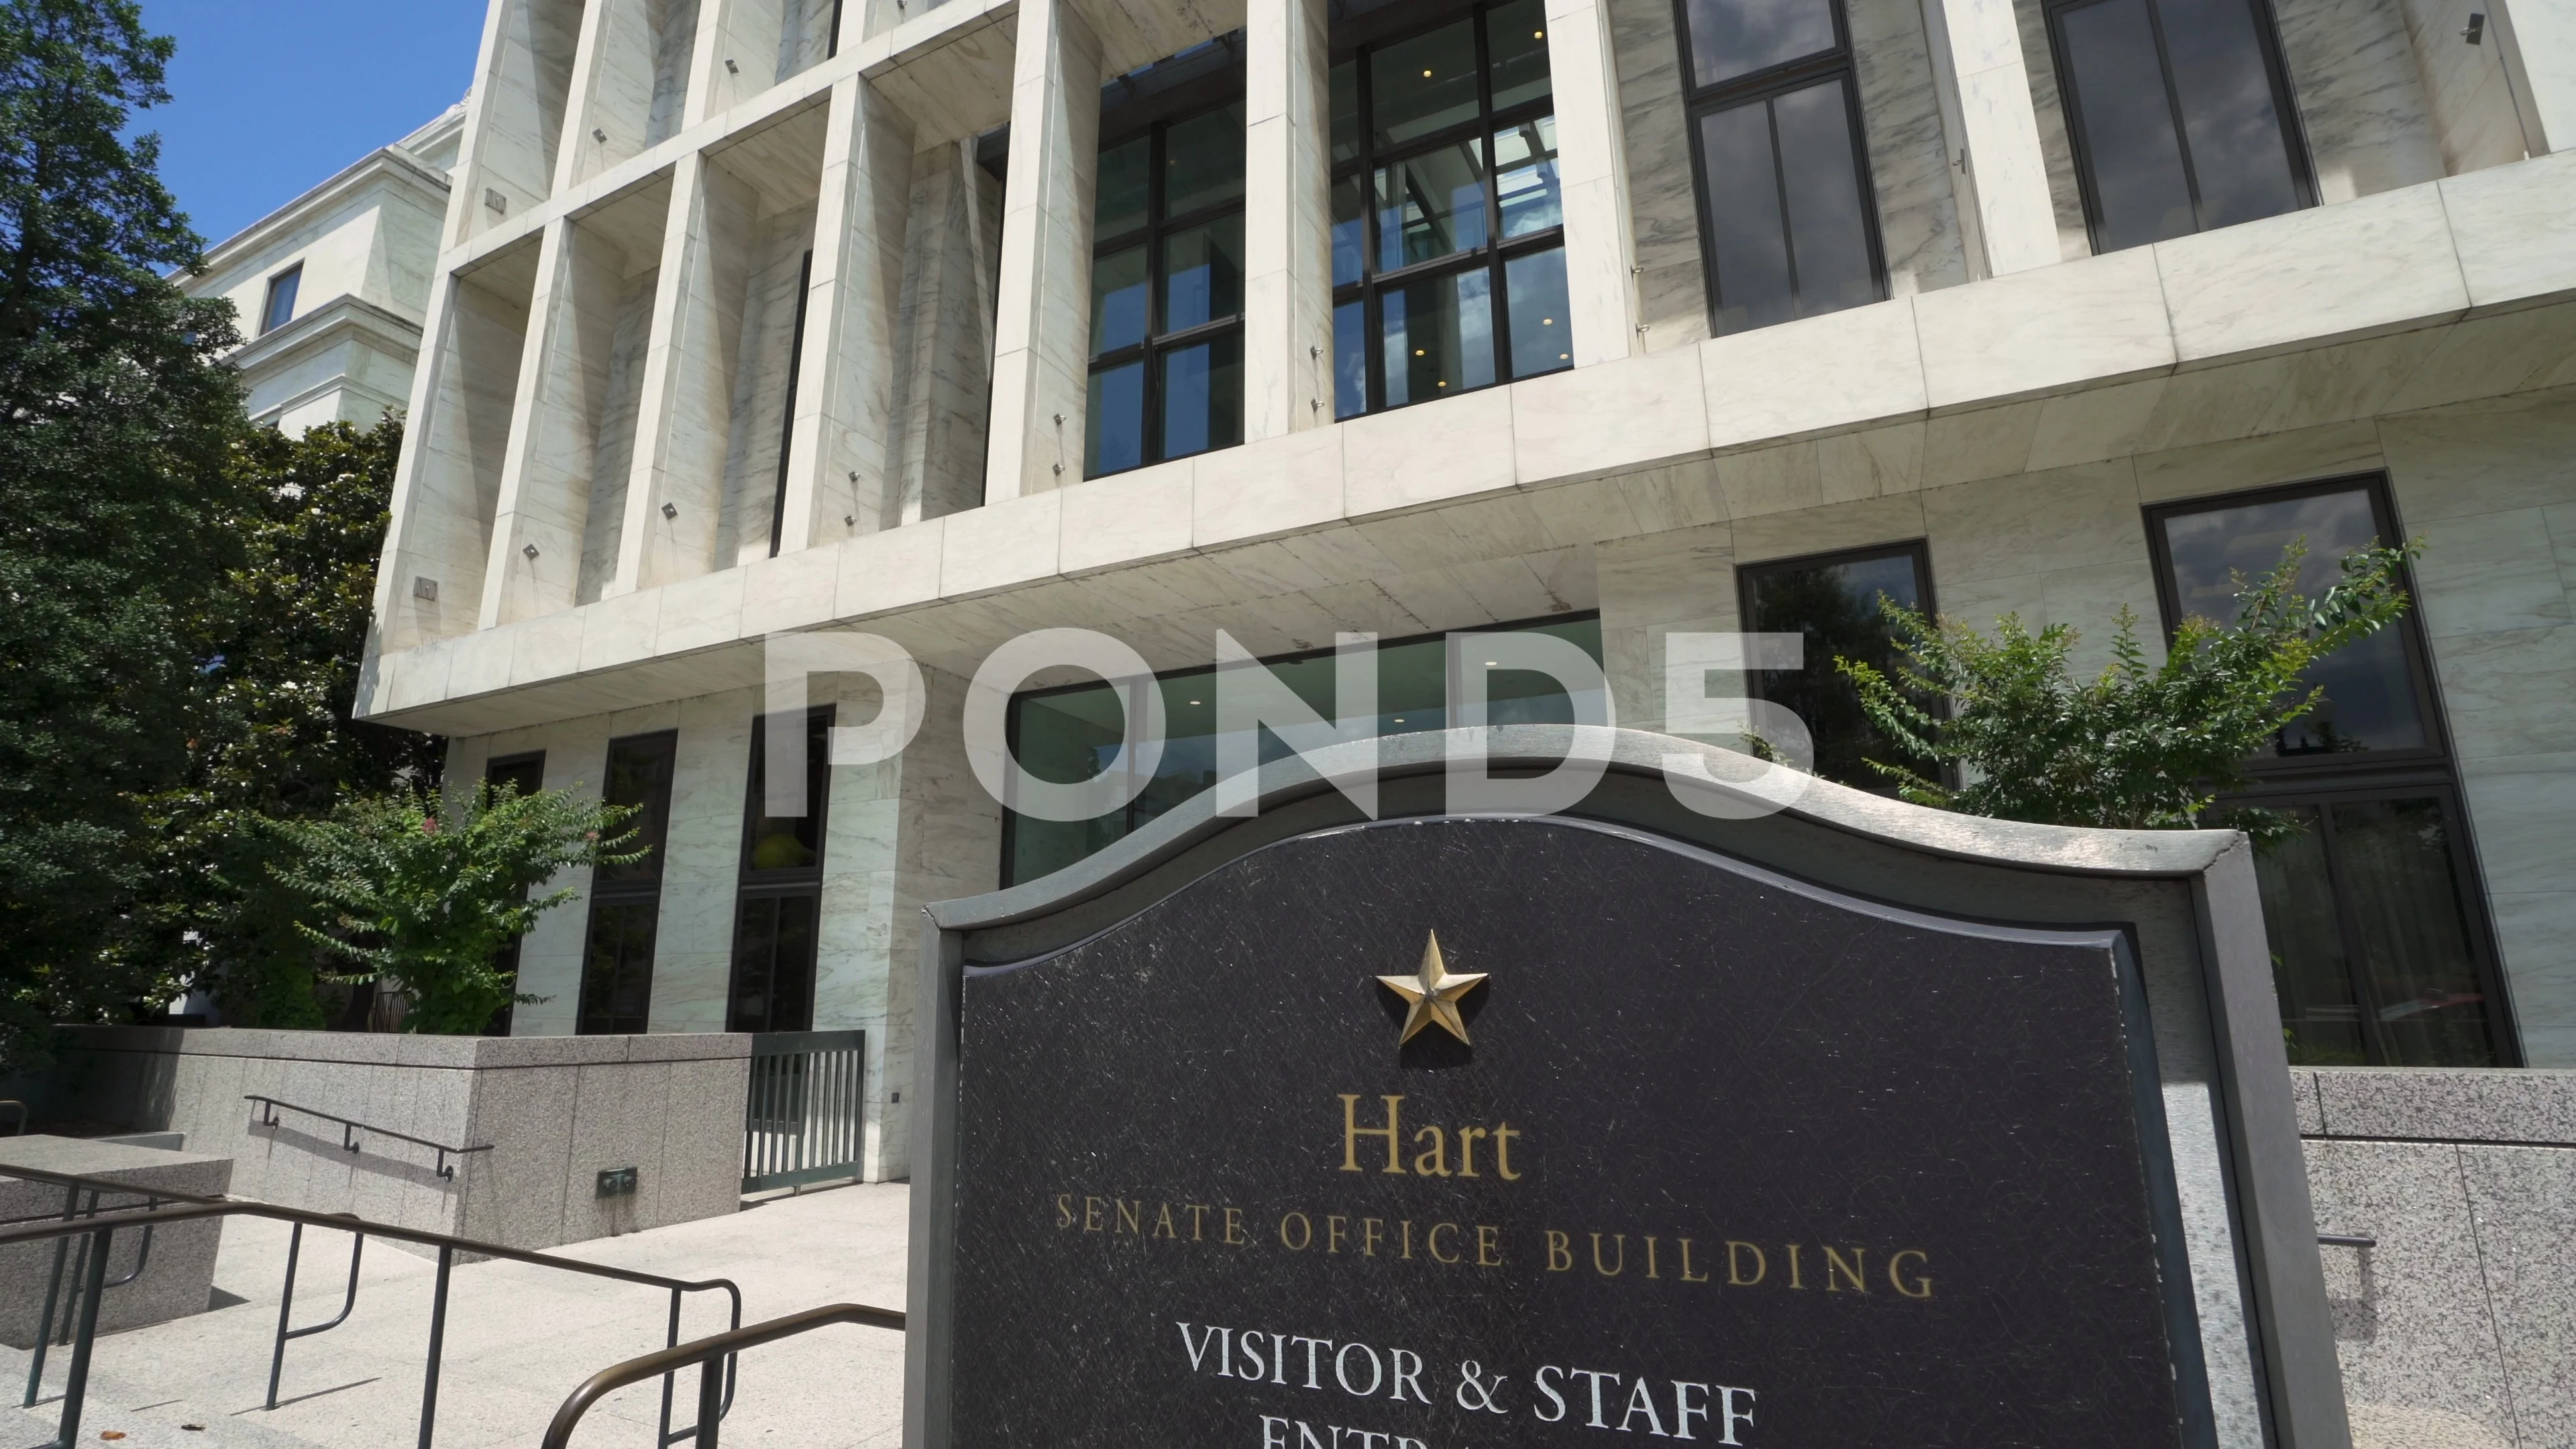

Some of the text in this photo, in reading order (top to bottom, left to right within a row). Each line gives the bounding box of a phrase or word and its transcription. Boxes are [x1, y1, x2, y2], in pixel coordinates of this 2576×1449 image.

[1337, 1093, 1521, 1181] Hart
[1055, 1193, 1935, 1299] SENATE OFFICE BUILDING
[1175, 1322, 1756, 1446] VISITOR & STAFF
